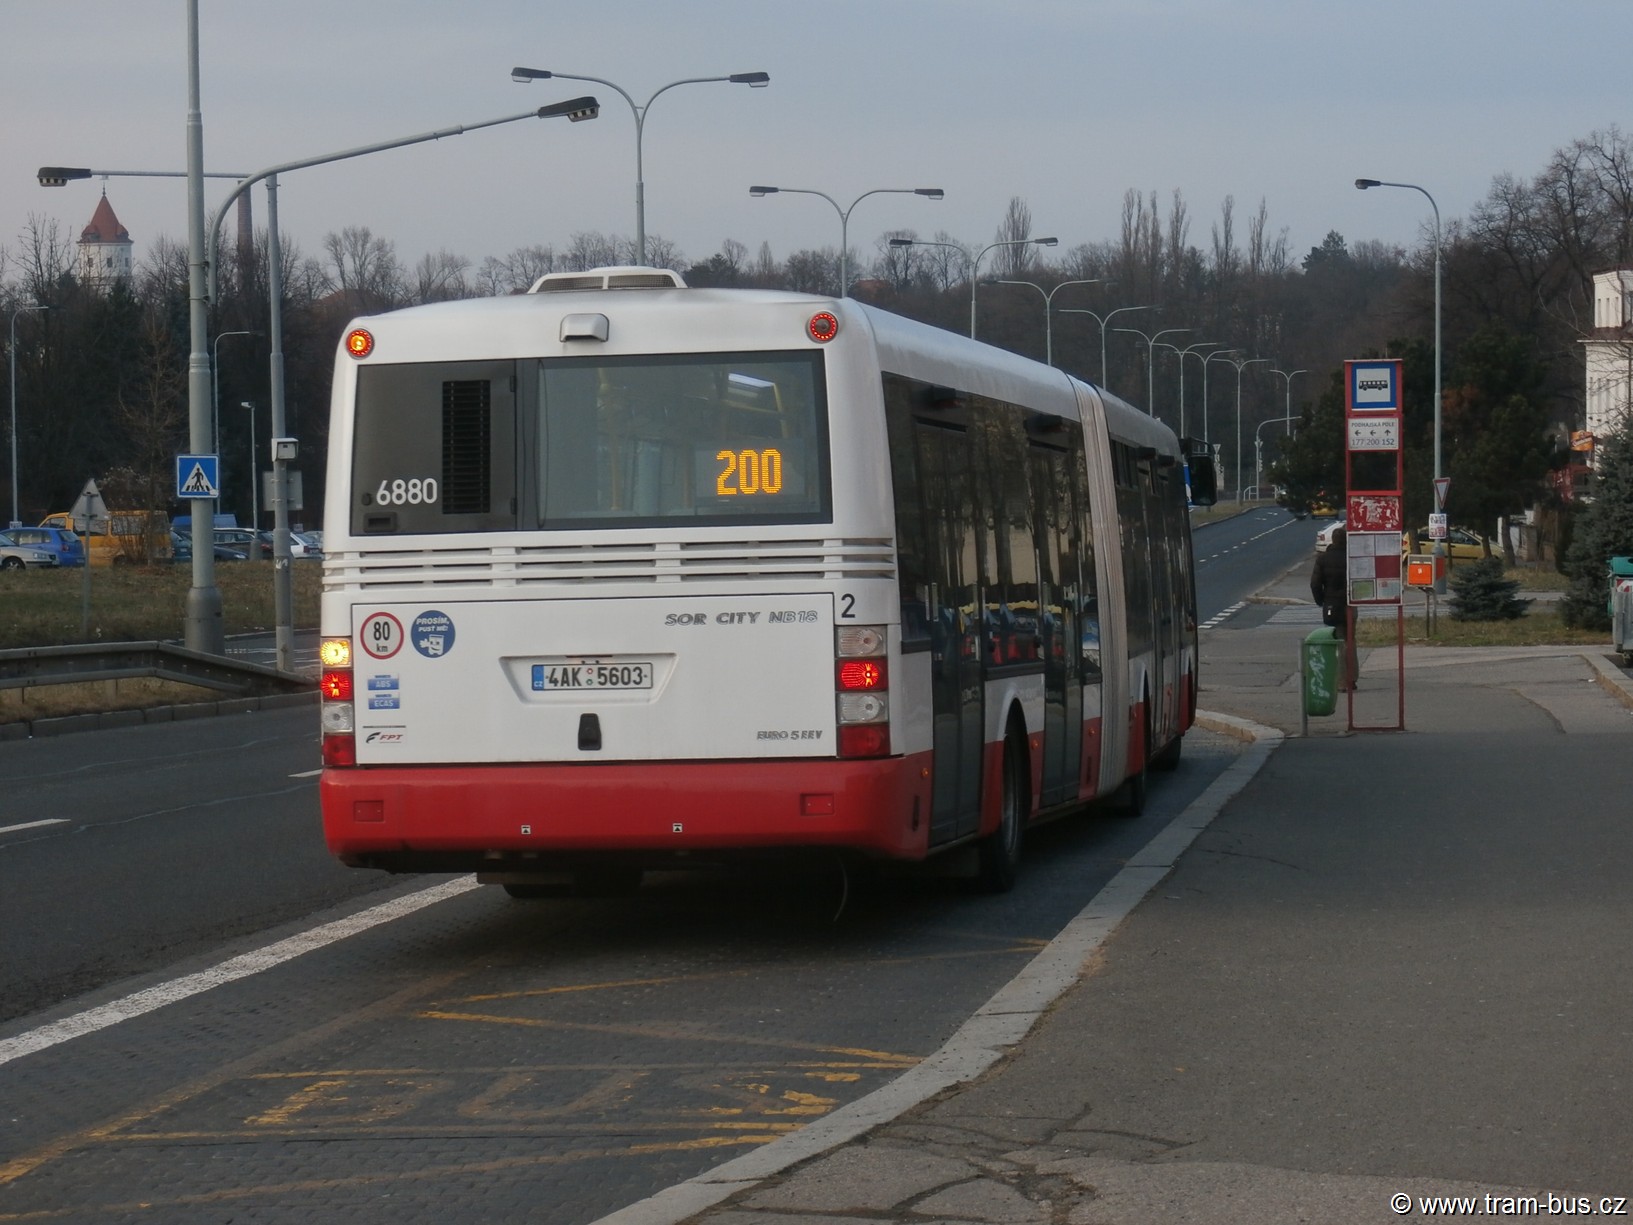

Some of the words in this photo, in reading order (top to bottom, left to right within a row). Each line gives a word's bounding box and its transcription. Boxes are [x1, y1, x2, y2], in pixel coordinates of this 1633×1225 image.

[1352, 438, 1364, 446] 177
[1366, 438, 1380, 446] 200
[1381, 438, 1395, 446] 152
[716, 448, 782, 496] 200
[376, 477, 438, 506] 6880
[841, 592, 856, 619] 2
[665, 612, 708, 627] SOR
[716, 611, 761, 625] CITY
[768, 610, 819, 624] NB18
[373, 621, 391, 641] 80
[376, 643, 389, 653] km
[375, 680, 392, 688] ABS
[533, 680, 544, 688] CZ
[548, 667, 582, 687] 4AK
[597, 666, 643, 686] 5603
[757, 730, 789, 740] EURO
[790, 730, 800, 740] 5
[801, 730, 823, 740] EEV
